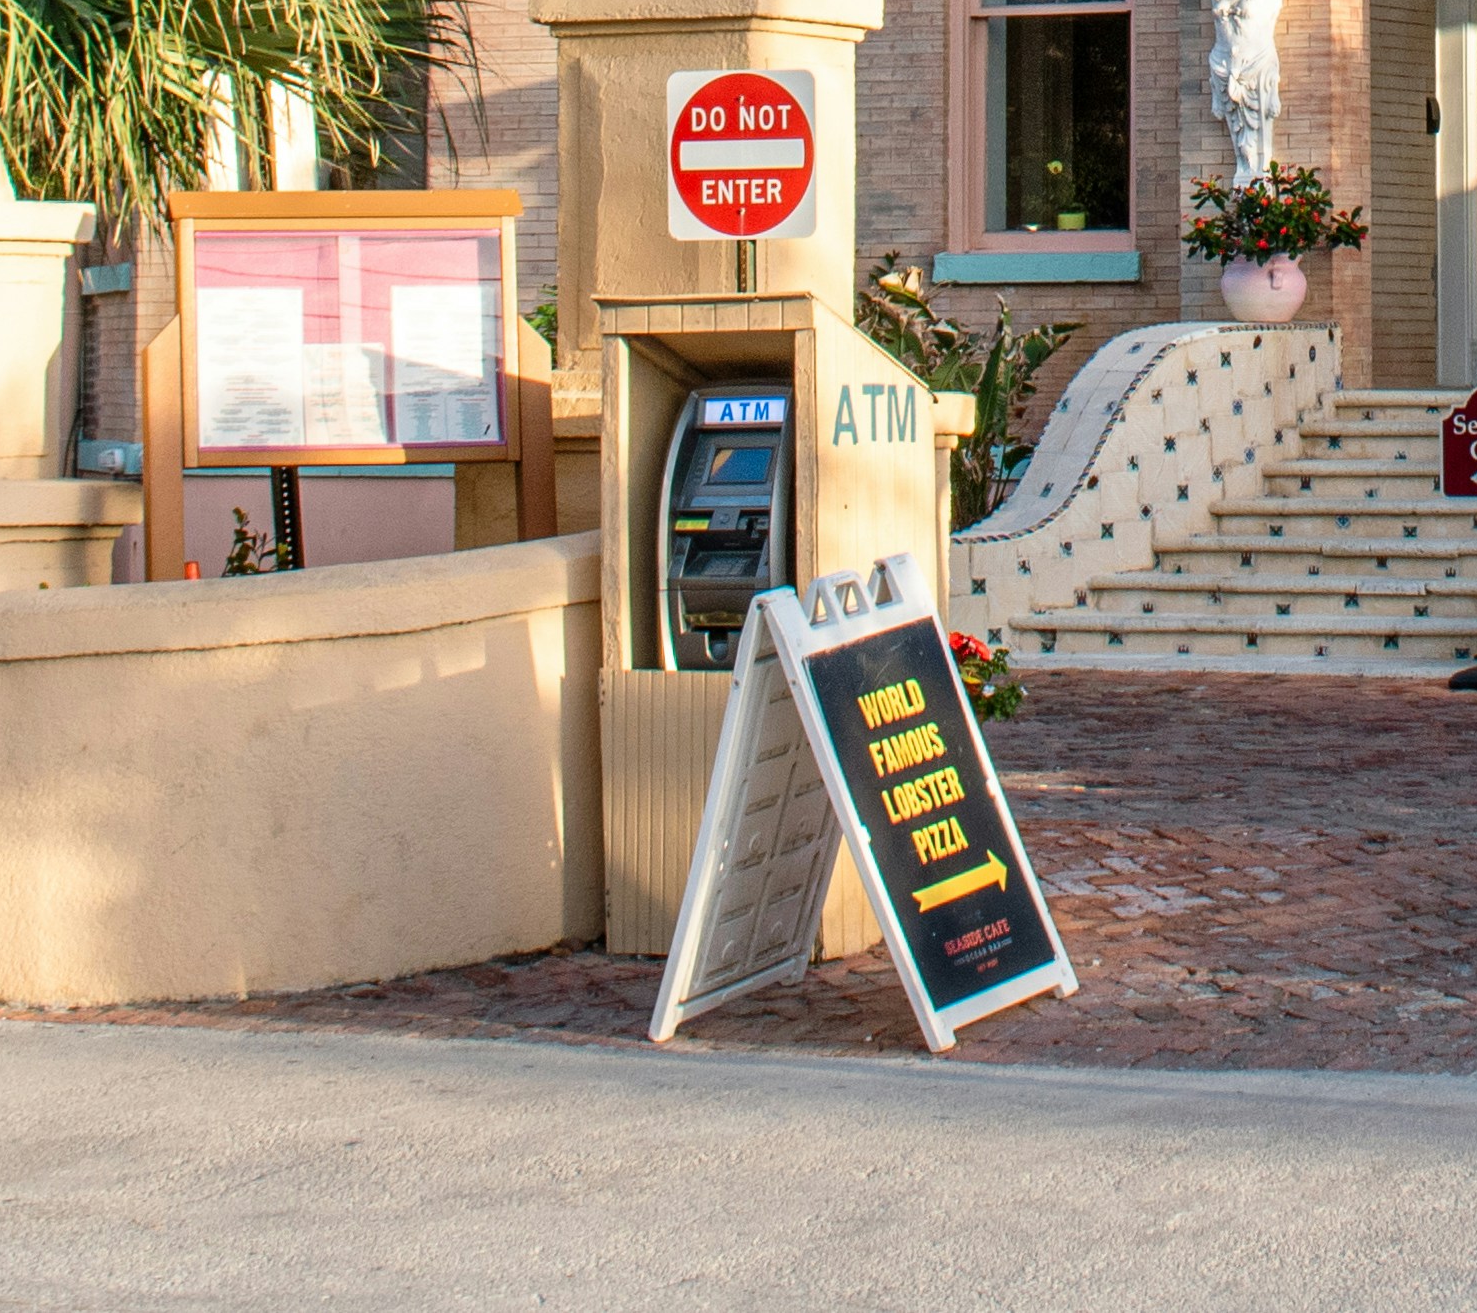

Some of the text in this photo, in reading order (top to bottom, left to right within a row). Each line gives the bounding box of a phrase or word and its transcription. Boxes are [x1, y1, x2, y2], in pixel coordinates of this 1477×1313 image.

[691, 105, 792, 132] DO NOT
[702, 178, 782, 205] ENTER
[720, 402, 770, 422] ATM
[832, 384, 916, 447] ATM
[857, 678, 926, 730] WORLD
[868, 722, 946, 778] FAMOUS
[881, 766, 965, 824] LOBSTER
[911, 816, 969, 865] PIZZA
[944, 929, 985, 957] SEASIDE
